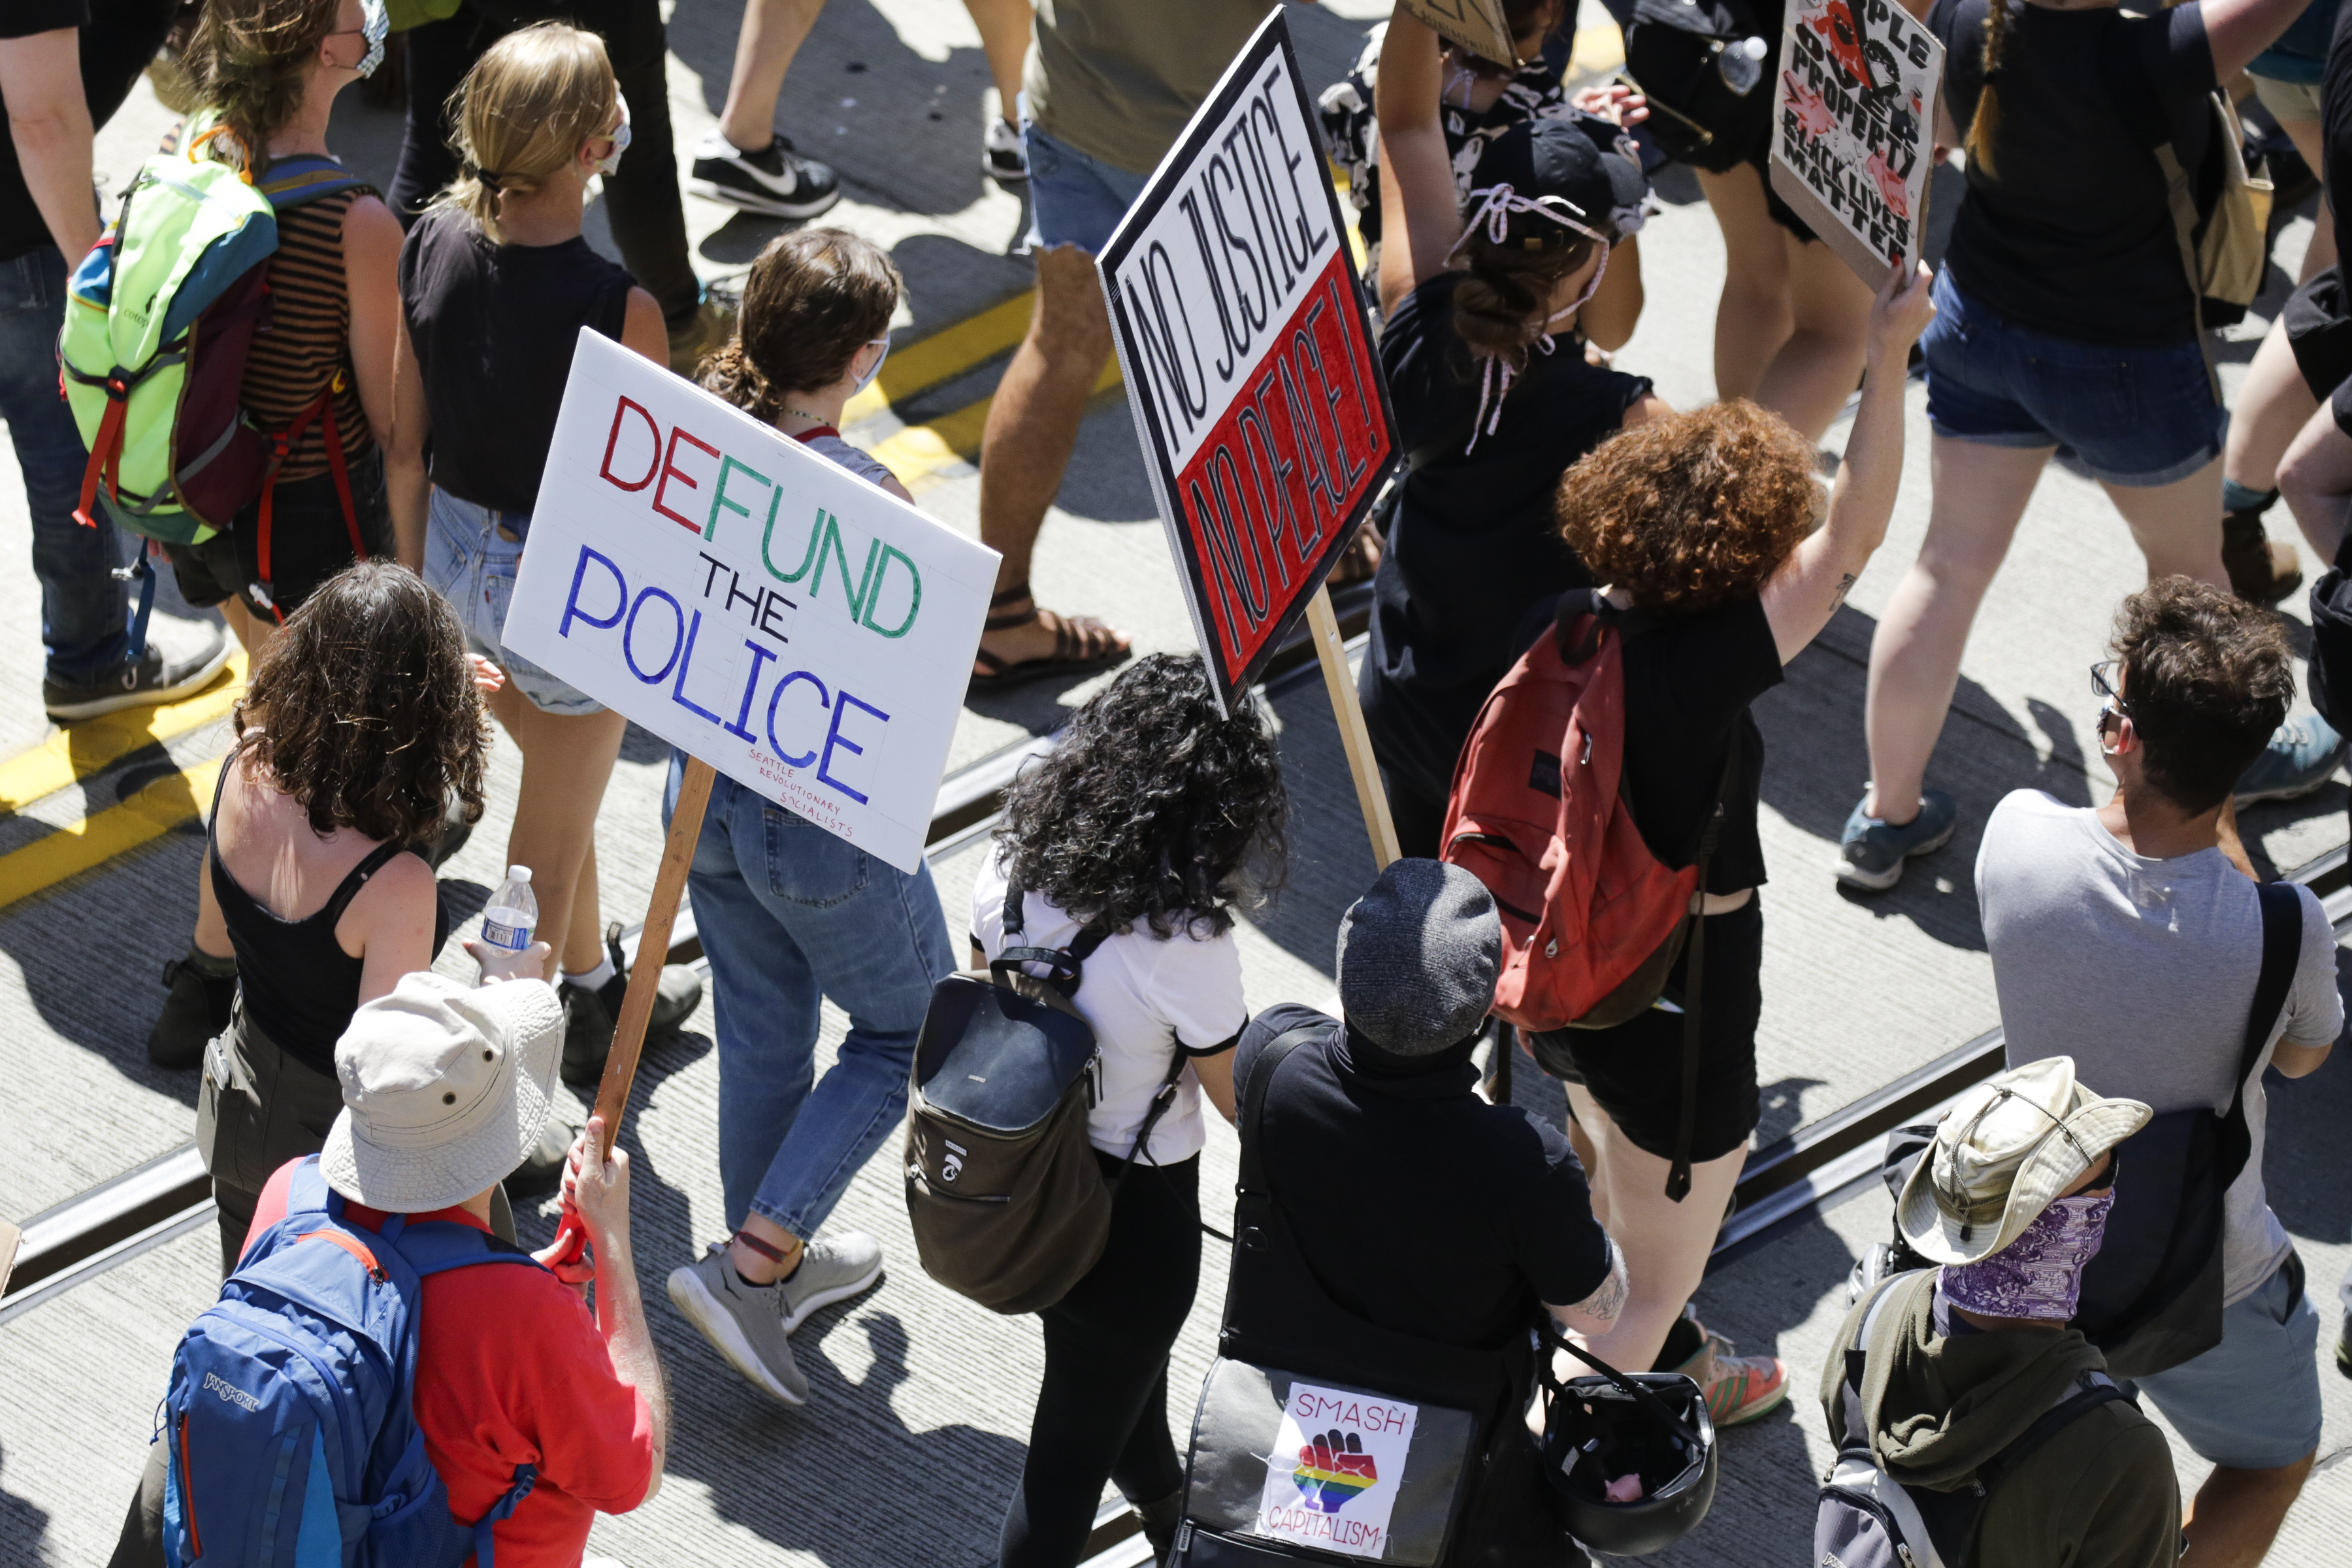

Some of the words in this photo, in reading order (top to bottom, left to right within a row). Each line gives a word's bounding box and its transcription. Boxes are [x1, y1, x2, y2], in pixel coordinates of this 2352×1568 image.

[1863, 0, 1931, 69] PLE
[1792, 41, 1917, 180] PROPERTY
[1795, 24, 1919, 155] OVER
[1784, 106, 1846, 192] BLACK
[1849, 171, 1909, 246] LIVES
[1784, 136, 1906, 261] MATTER
[1125, 239, 1207, 454] NO
[1179, 66, 1328, 382] JUSTICE
[123, 308, 148, 329] cotop
[600, 395, 922, 638] DEFUND
[1190, 444, 1269, 657] NO
[699, 551, 797, 644] THE
[559, 544, 890, 806] POLICE
[749, 749, 795, 778] SEATTLE
[759, 767, 840, 815] REVOLUTIONARY
[780, 792, 853, 837] SOCIALISTS
[203, 1372, 259, 1413] JANSPORT
[1296, 1393, 1406, 1435] SMASH
[1269, 1506, 1380, 1550] CAPITALISM
